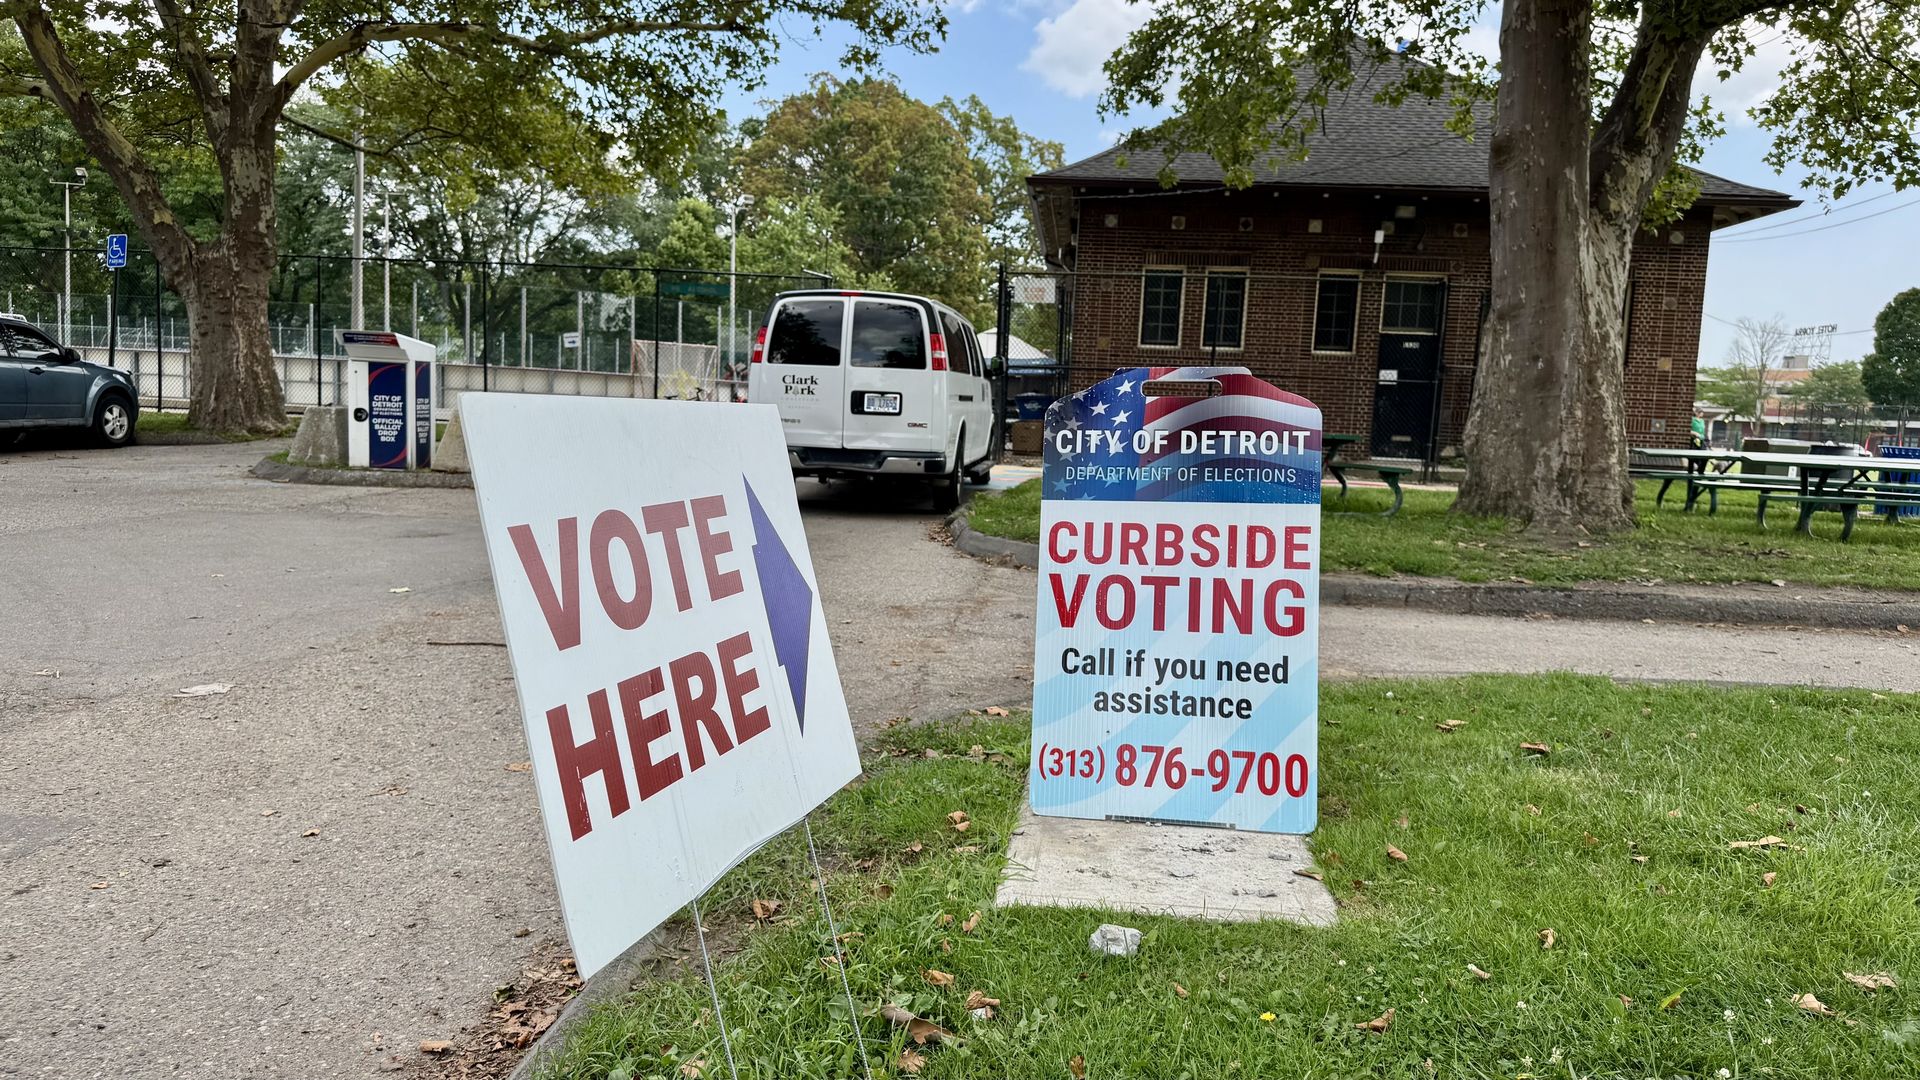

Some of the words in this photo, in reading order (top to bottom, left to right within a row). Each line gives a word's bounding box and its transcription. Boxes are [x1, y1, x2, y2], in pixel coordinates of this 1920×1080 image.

[782, 374, 819, 385] Clark
[1055, 429, 1122, 455] CITY
[1132, 429, 1169, 455] OF
[1180, 430, 1311, 456] DETROIT
[1065, 466, 1172, 482] DEPARTMENT
[1177, 467, 1198, 483] OF
[1204, 467, 1297, 484] ELECTIONS
[1048, 520, 1312, 570] CURBSIDE
[506, 493, 744, 652] VOTE
[1048, 573, 1307, 637] VOTING
[1061, 647, 1115, 676] Call
[1125, 648, 1146, 677] if
[1154, 656, 1206, 686] you
[1216, 655, 1290, 685] need
[1093, 686, 1253, 719] assistance
[545, 630, 772, 843] HERE
[1038, 742, 1106, 785] (313)
[1115, 743, 1309, 798] 876-9700
